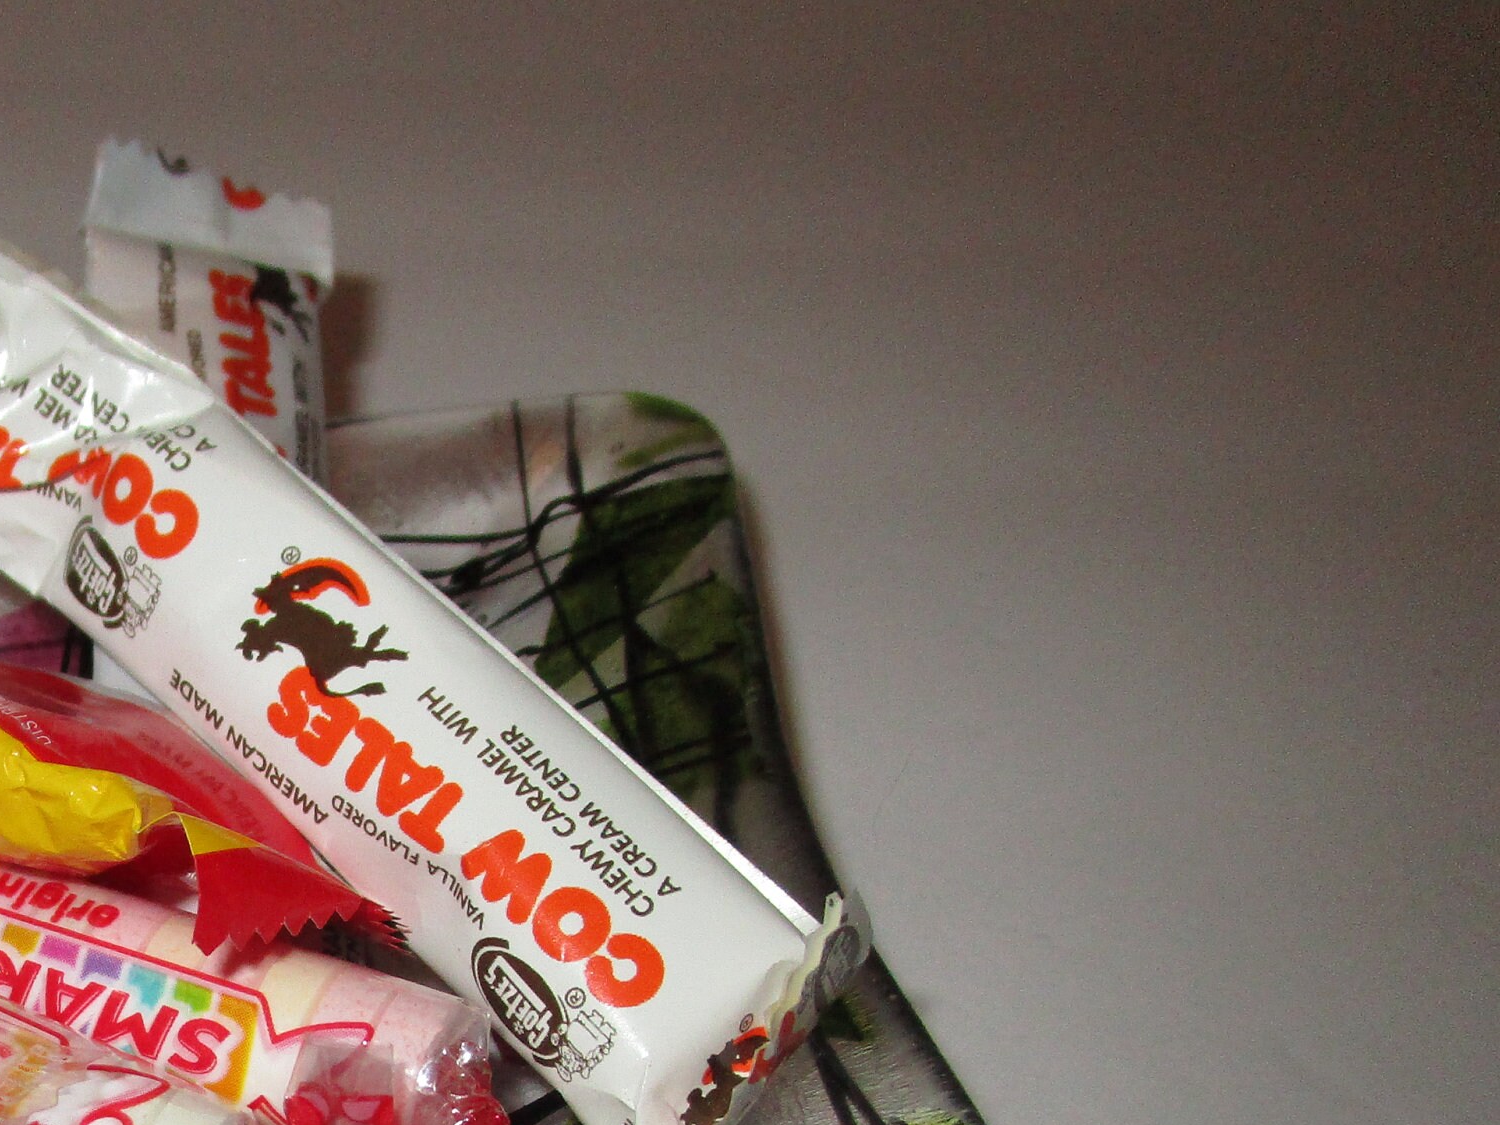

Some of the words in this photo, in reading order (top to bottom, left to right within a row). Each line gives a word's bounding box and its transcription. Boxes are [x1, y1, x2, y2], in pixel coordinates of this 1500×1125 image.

[47, 446, 199, 559] COW
[168, 667, 226, 726] MADE
[416, 685, 480, 746] WITH
[225, 726, 329, 825] AMERICAN
[266, 665, 465, 854] TALES
[475, 737, 577, 839] CARAMEL
[498, 723, 584, 805] CENTER
[330, 794, 428, 867] FLAVORED
[574, 801, 659, 879] CREAM
[427, 858, 485, 932] VANILLA
[569, 838, 656, 918] CHEWY
[661, 875, 683, 898] A
[460, 828, 666, 1009] COW
